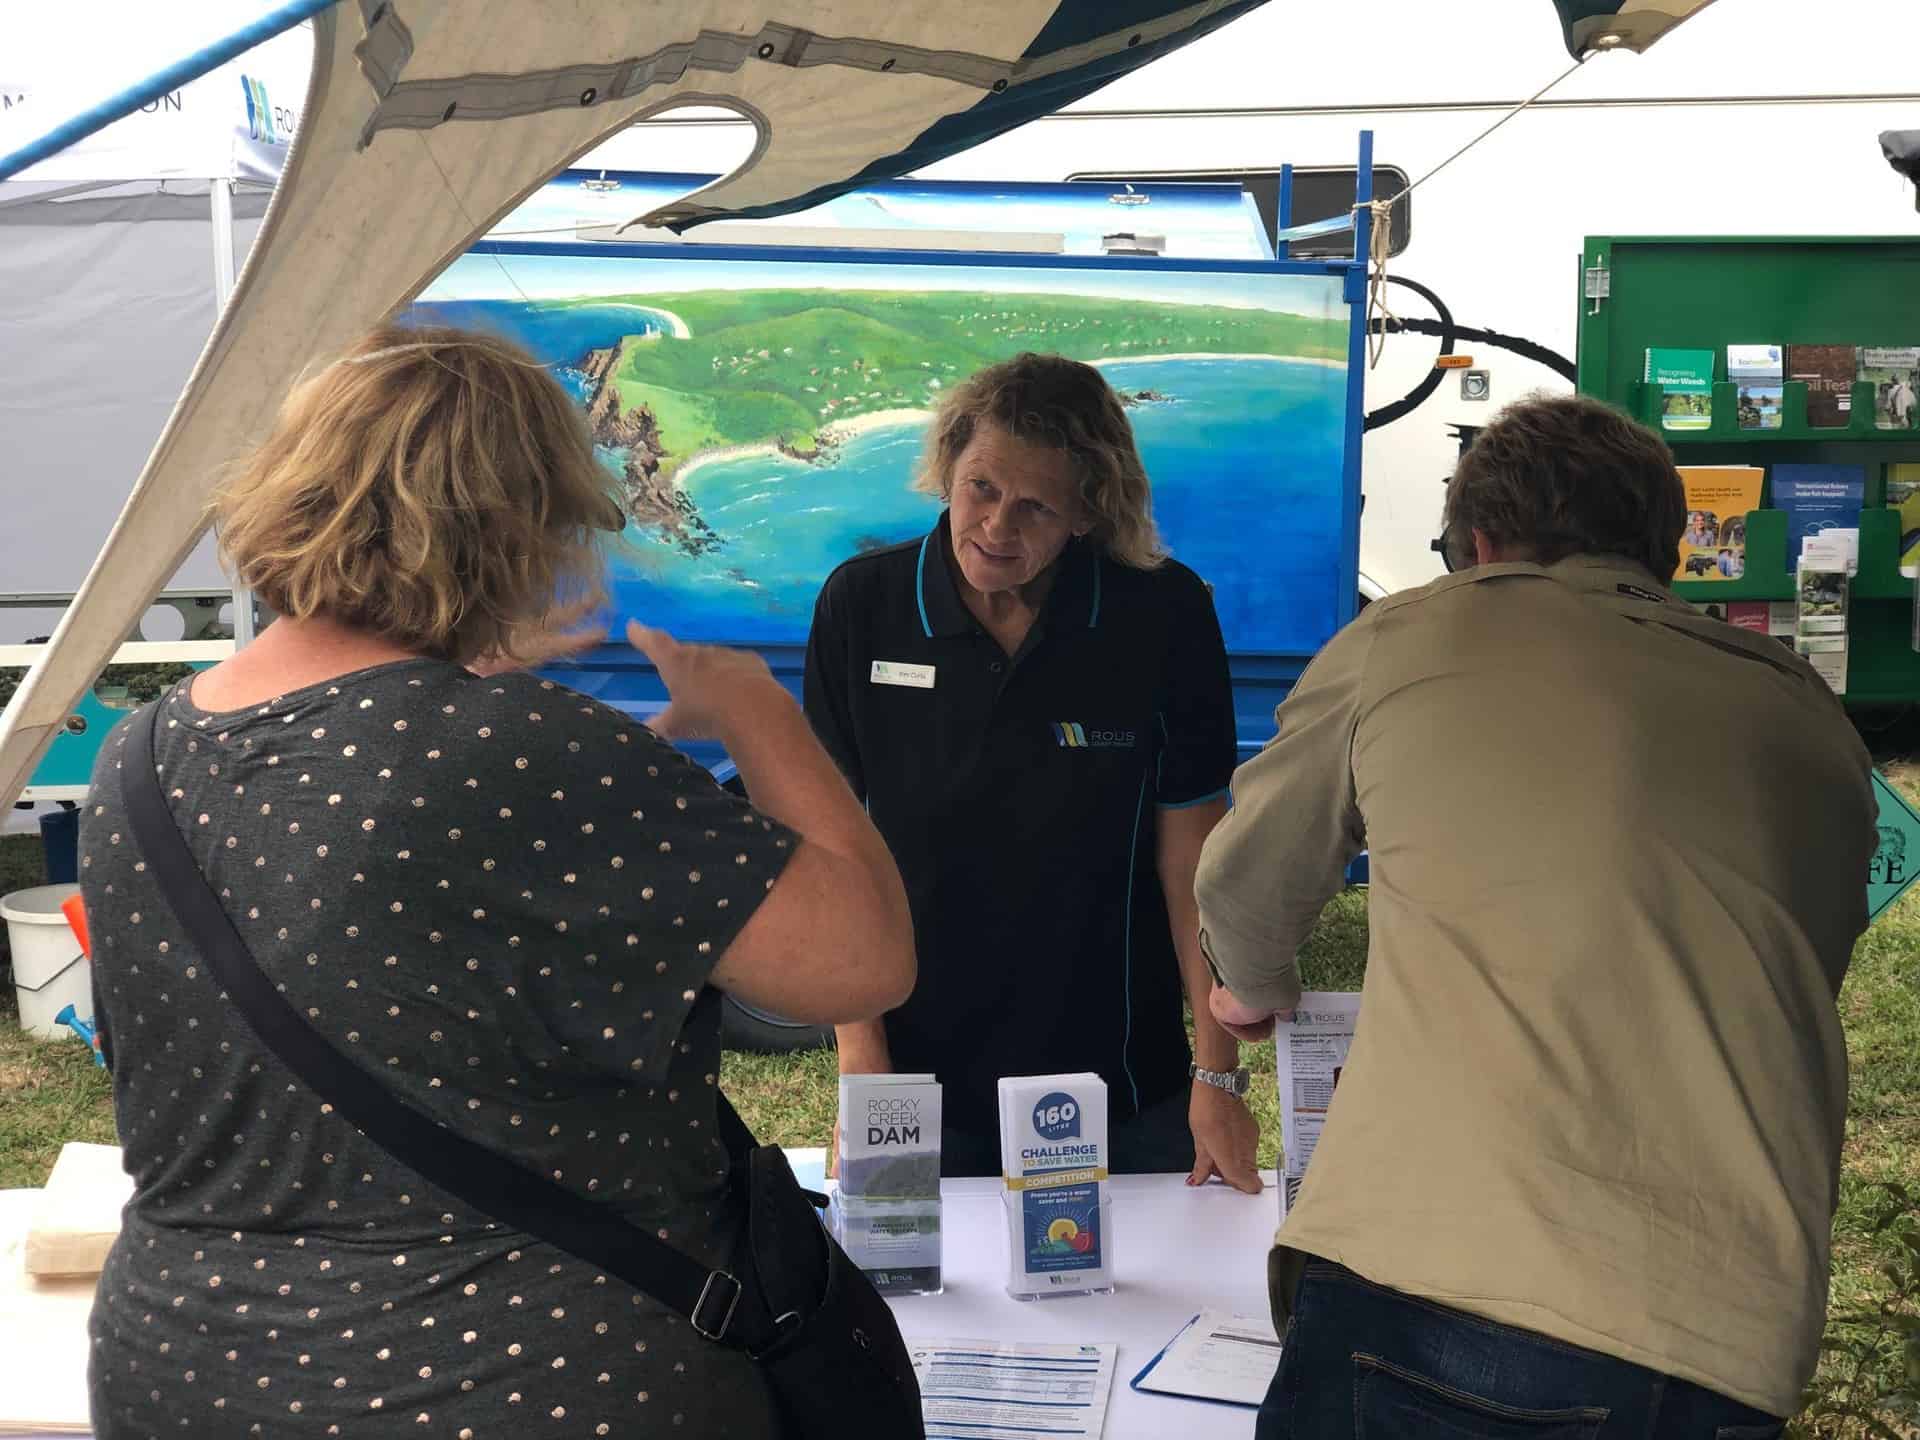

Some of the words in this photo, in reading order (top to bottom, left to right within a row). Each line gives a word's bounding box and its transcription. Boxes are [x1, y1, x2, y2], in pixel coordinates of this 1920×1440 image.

[1657, 376, 1680, 385] Water
[1823, 379, 1850, 391] Test
[1091, 730, 1136, 742] ROUS
[1315, 1014, 1345, 1022] ROUS
[867, 1098, 921, 1112] ROCKY
[867, 1111, 921, 1126] CREEK
[1036, 1102, 1076, 1128] 160
[867, 1126, 921, 1146] DAM
[1021, 1144, 1098, 1159] CHALLENGE
[1023, 1159, 1036, 1168] TO
[1037, 1157, 1062, 1166] SAVE
[1064, 1155, 1098, 1165] WATER
[1025, 1170, 1096, 1188] COMPETITION
